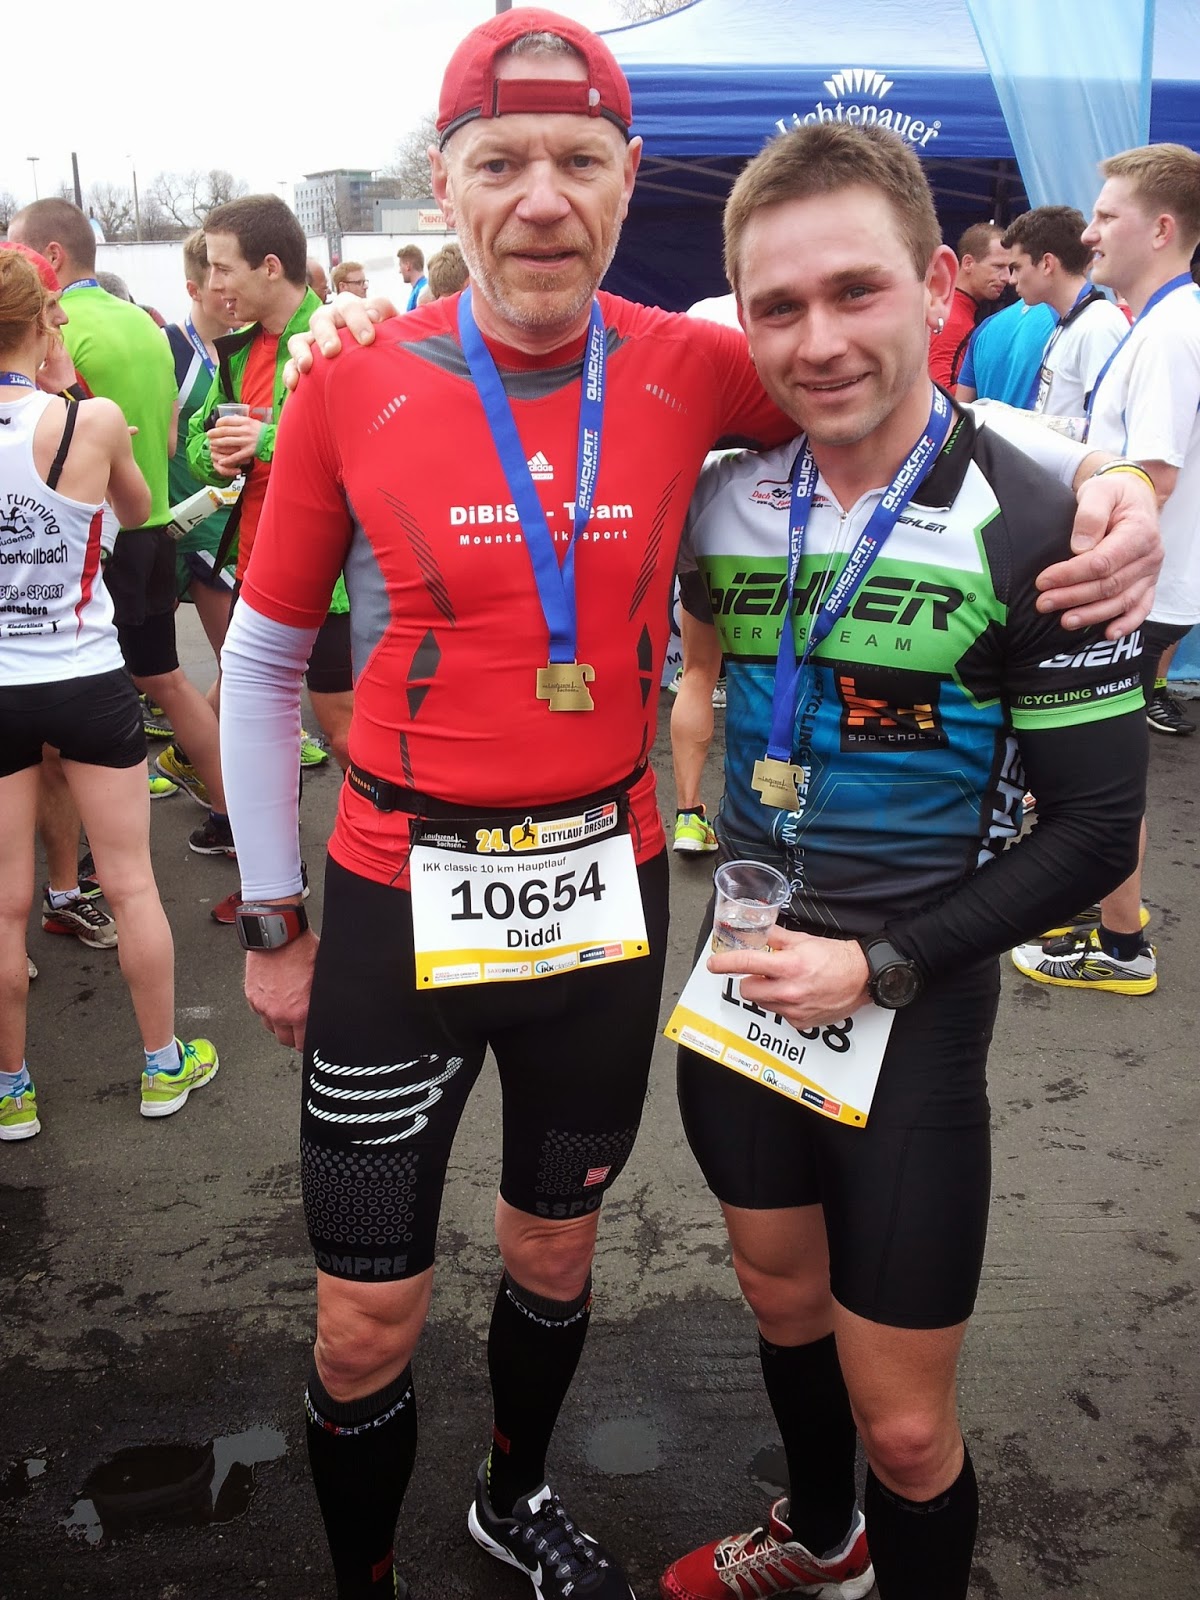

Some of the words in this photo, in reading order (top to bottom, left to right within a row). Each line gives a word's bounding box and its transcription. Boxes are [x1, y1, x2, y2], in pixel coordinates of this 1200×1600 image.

[27, 584, 64, 600] SPORT
[1095, 677, 1132, 696] WEAR
[475, 828, 510, 853] 24.
[541, 827, 583, 844] CITYLAUF
[584, 815, 614, 835] DRESDEN
[423, 863, 441, 872] IKK
[444, 863, 478, 872] classic
[481, 864, 494, 874] 10
[497, 865, 514, 874] km
[518, 856, 566, 872] Hauptlauf
[451, 861, 606, 920] 10654
[507, 922, 562, 948] Diddi
[747, 1022, 806, 1065] Daniel
